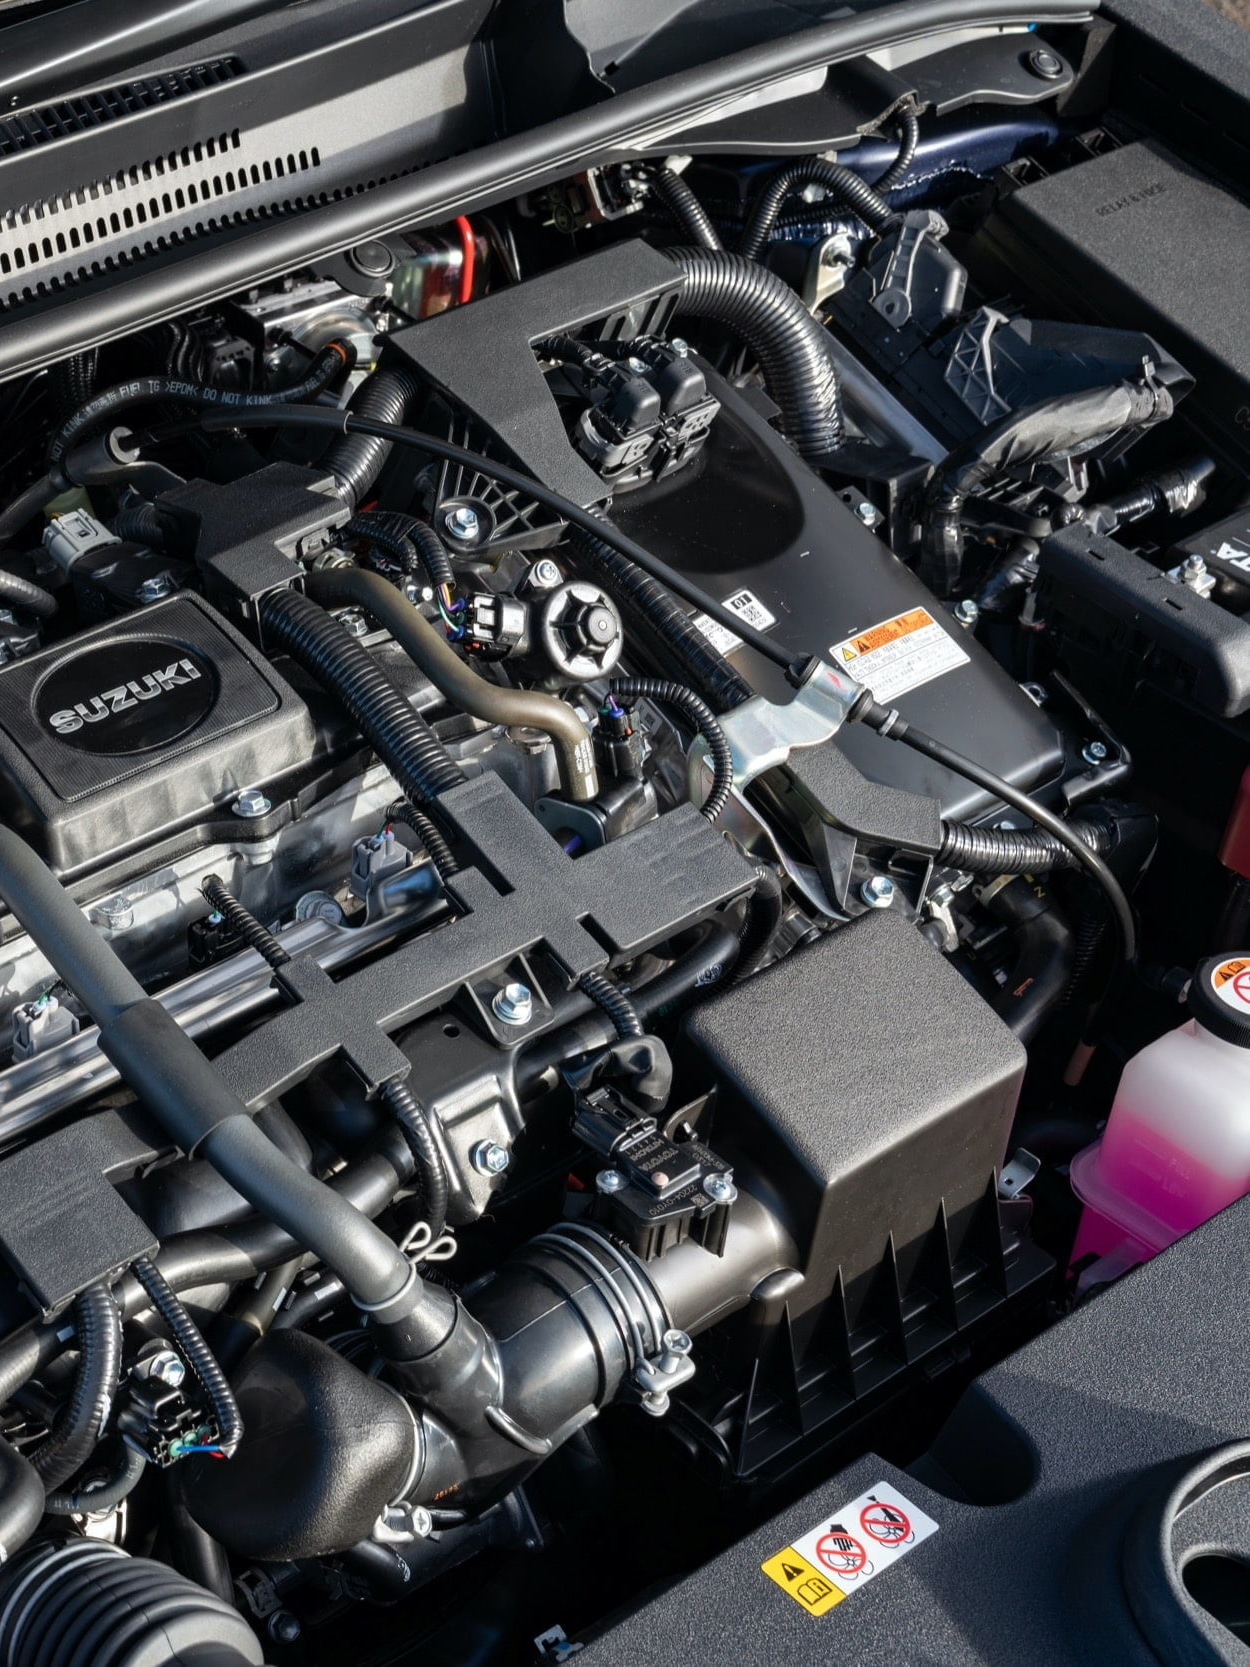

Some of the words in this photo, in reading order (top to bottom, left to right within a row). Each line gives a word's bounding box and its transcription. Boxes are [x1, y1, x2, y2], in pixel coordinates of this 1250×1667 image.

[51, 441, 64, 461] NOT
[62, 412, 85, 438] KINK
[148, 380, 161, 394] TG
[165, 381, 198, 396] >EPDM<
[203, 387, 217, 400] DO
[222, 391, 240, 404] NOT
[246, 394, 272, 405] KINK
[733, 596, 750, 608] 01
[50, 658, 202, 734] SUZUKI
[629, 1139, 664, 1162] HITACHI
[637, 1147, 679, 1172] TOYOTA
